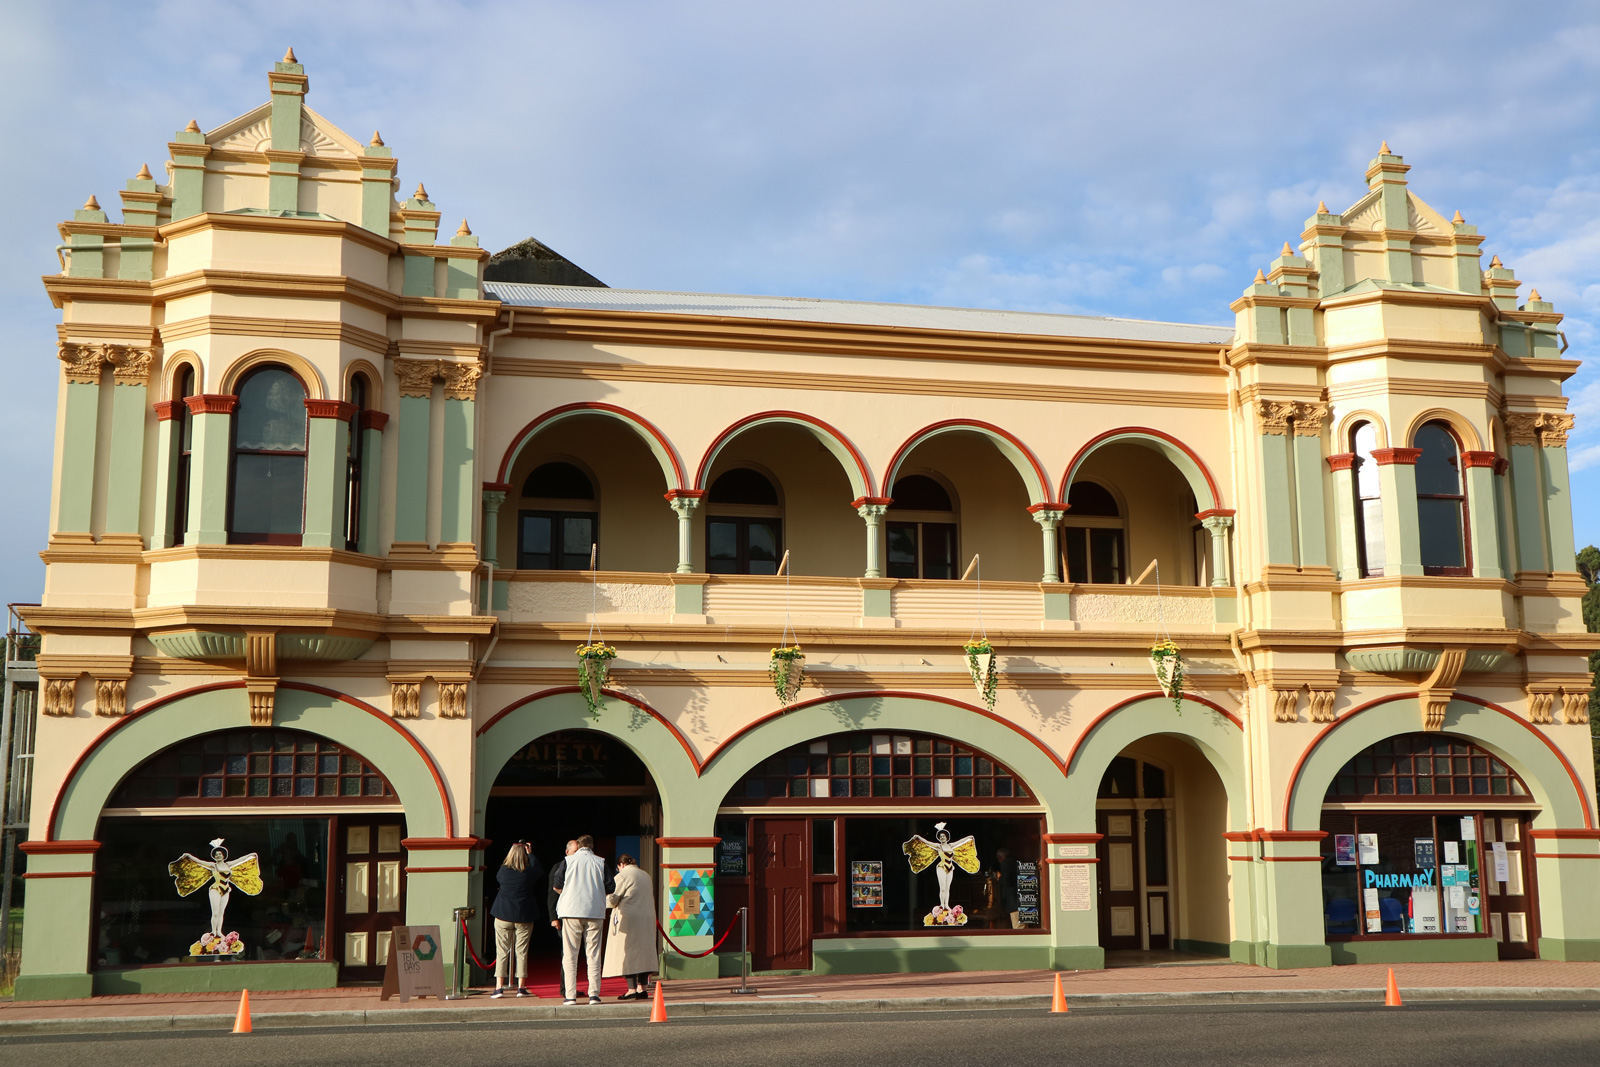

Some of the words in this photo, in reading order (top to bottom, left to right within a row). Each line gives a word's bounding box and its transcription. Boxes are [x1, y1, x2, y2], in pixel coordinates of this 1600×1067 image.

[1364, 869, 1433, 888] PHARMACY
[402, 952, 414, 961] TEN
[403, 961, 420, 971] DAYS
